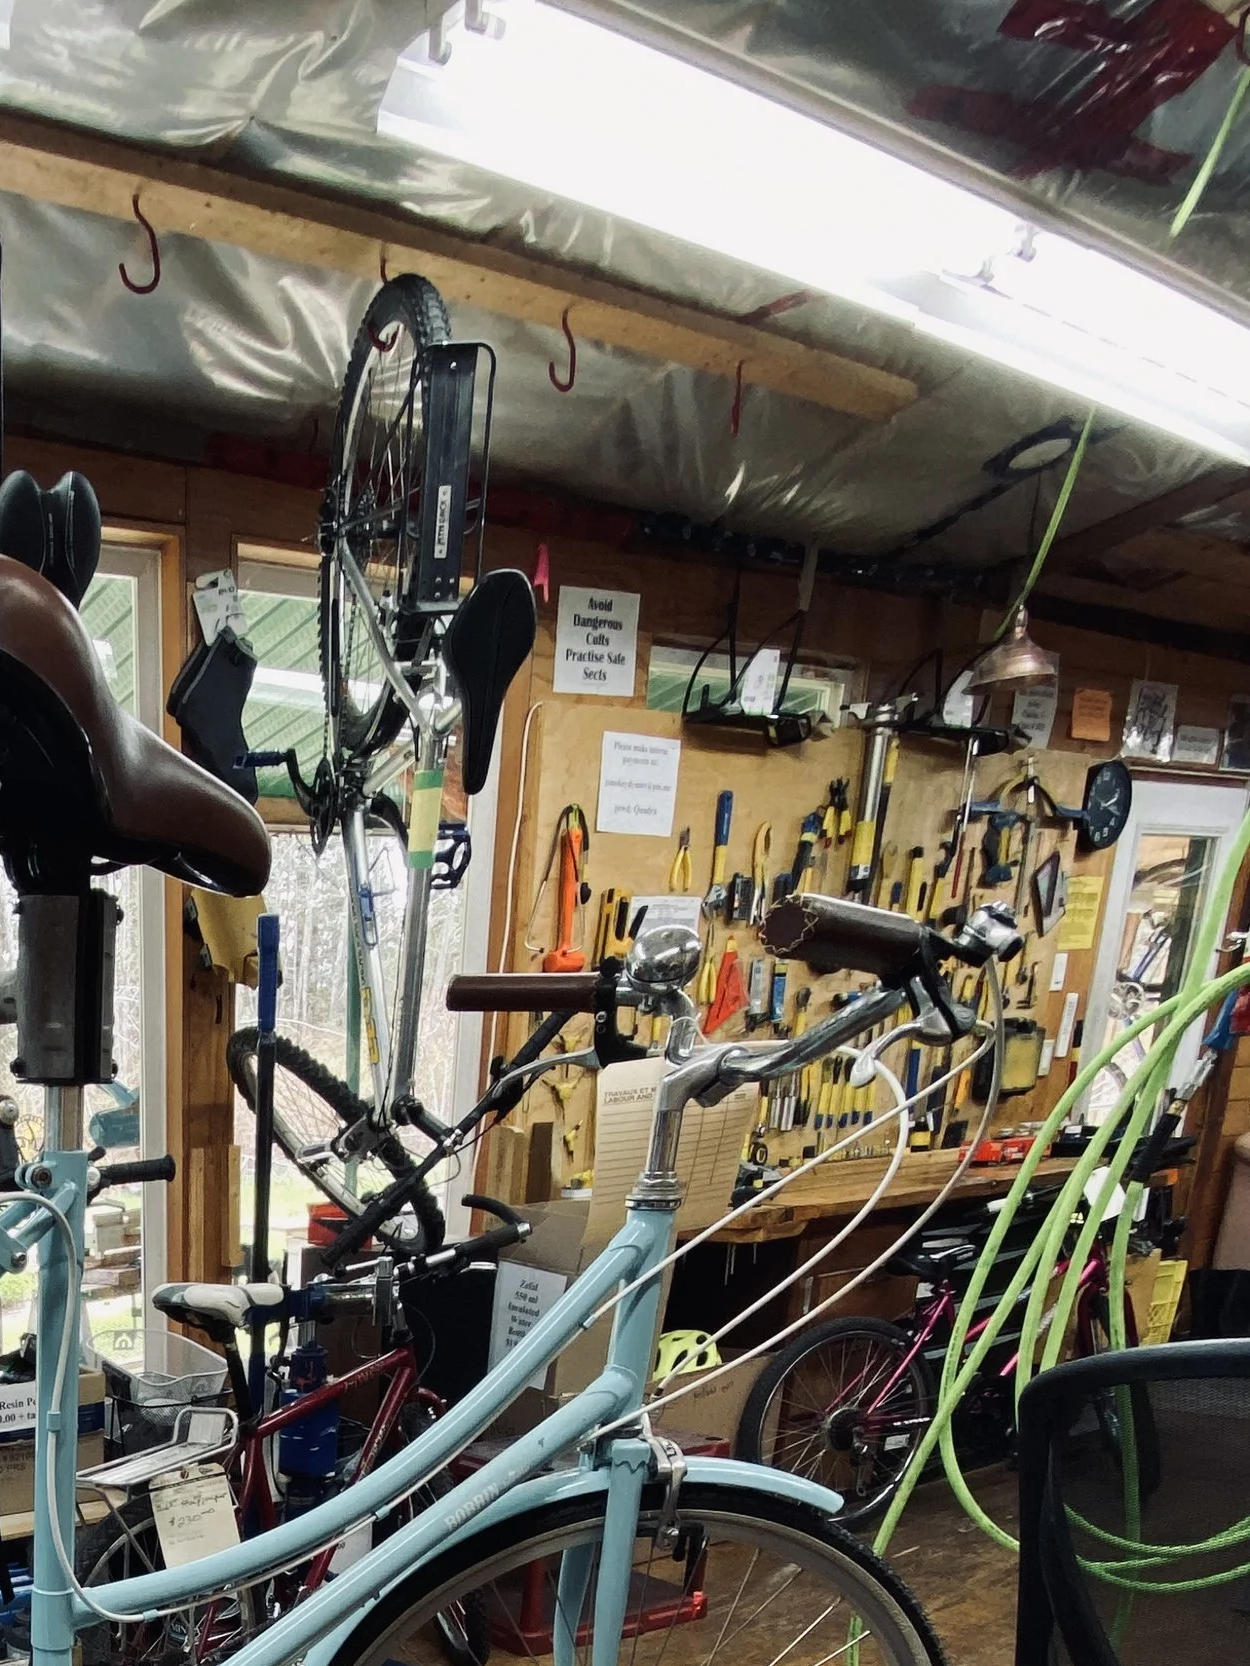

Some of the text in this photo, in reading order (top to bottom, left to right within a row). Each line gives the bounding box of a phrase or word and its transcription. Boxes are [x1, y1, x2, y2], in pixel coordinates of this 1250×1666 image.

[588, 597, 613, 612] Avoid
[573, 613, 623, 632] Dangerous
[585, 632, 610, 646] Cults
[565, 648, 626, 666] Practise Safe
[582, 667, 607, 681] Sects
[604, 1087, 639, 1098] TRAVAUX
[604, 1092, 653, 1104] LABOUR AND
[508, 1302, 540, 1317] Insulated
[0, 1401, 24, 1411] Resin
[27, 1412, 36, 1420] ta
[445, 1482, 500, 1529] BOBBIN
